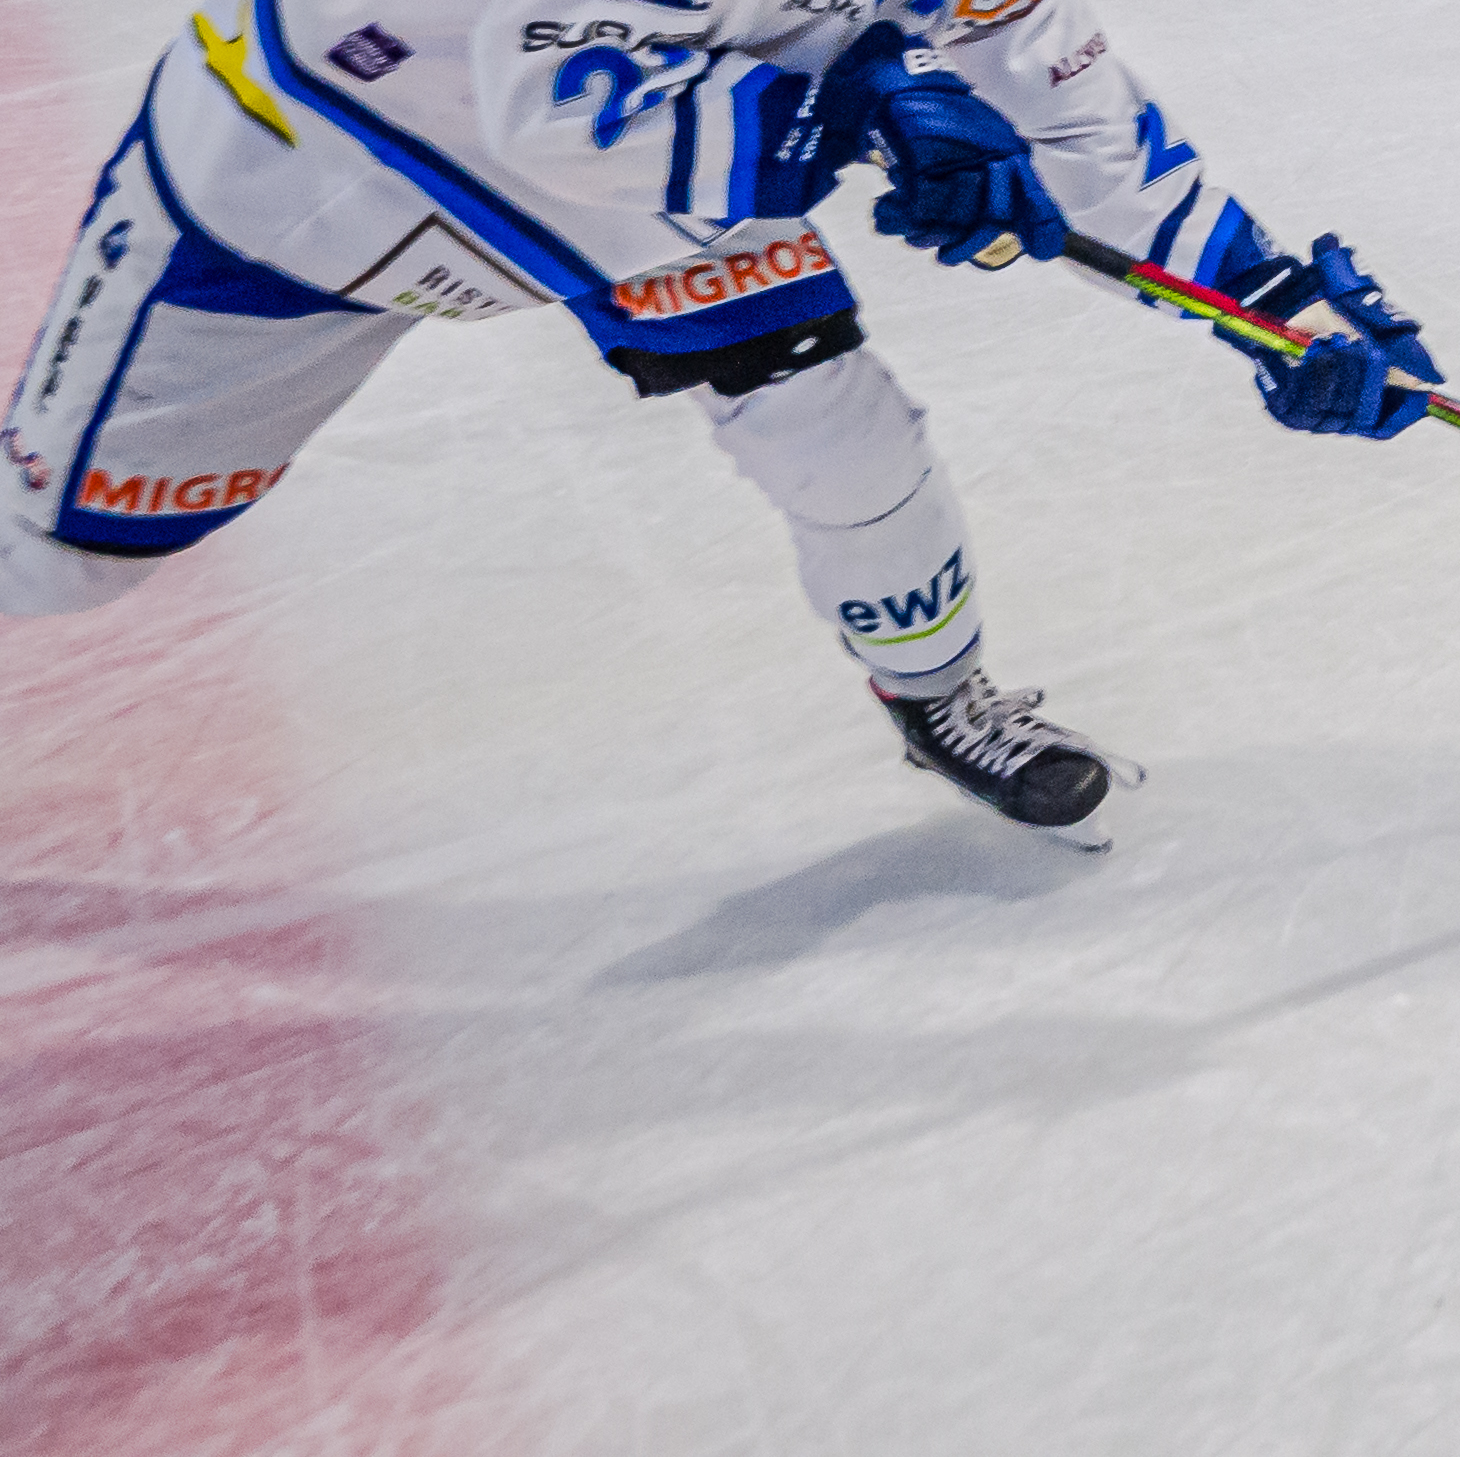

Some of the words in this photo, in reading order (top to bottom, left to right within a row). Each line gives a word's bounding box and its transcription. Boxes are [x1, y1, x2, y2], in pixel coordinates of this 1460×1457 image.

[611, 230, 833, 318] MIGROS
[74, 460, 292, 515] MIGR
[837, 544, 971, 634] ewz
